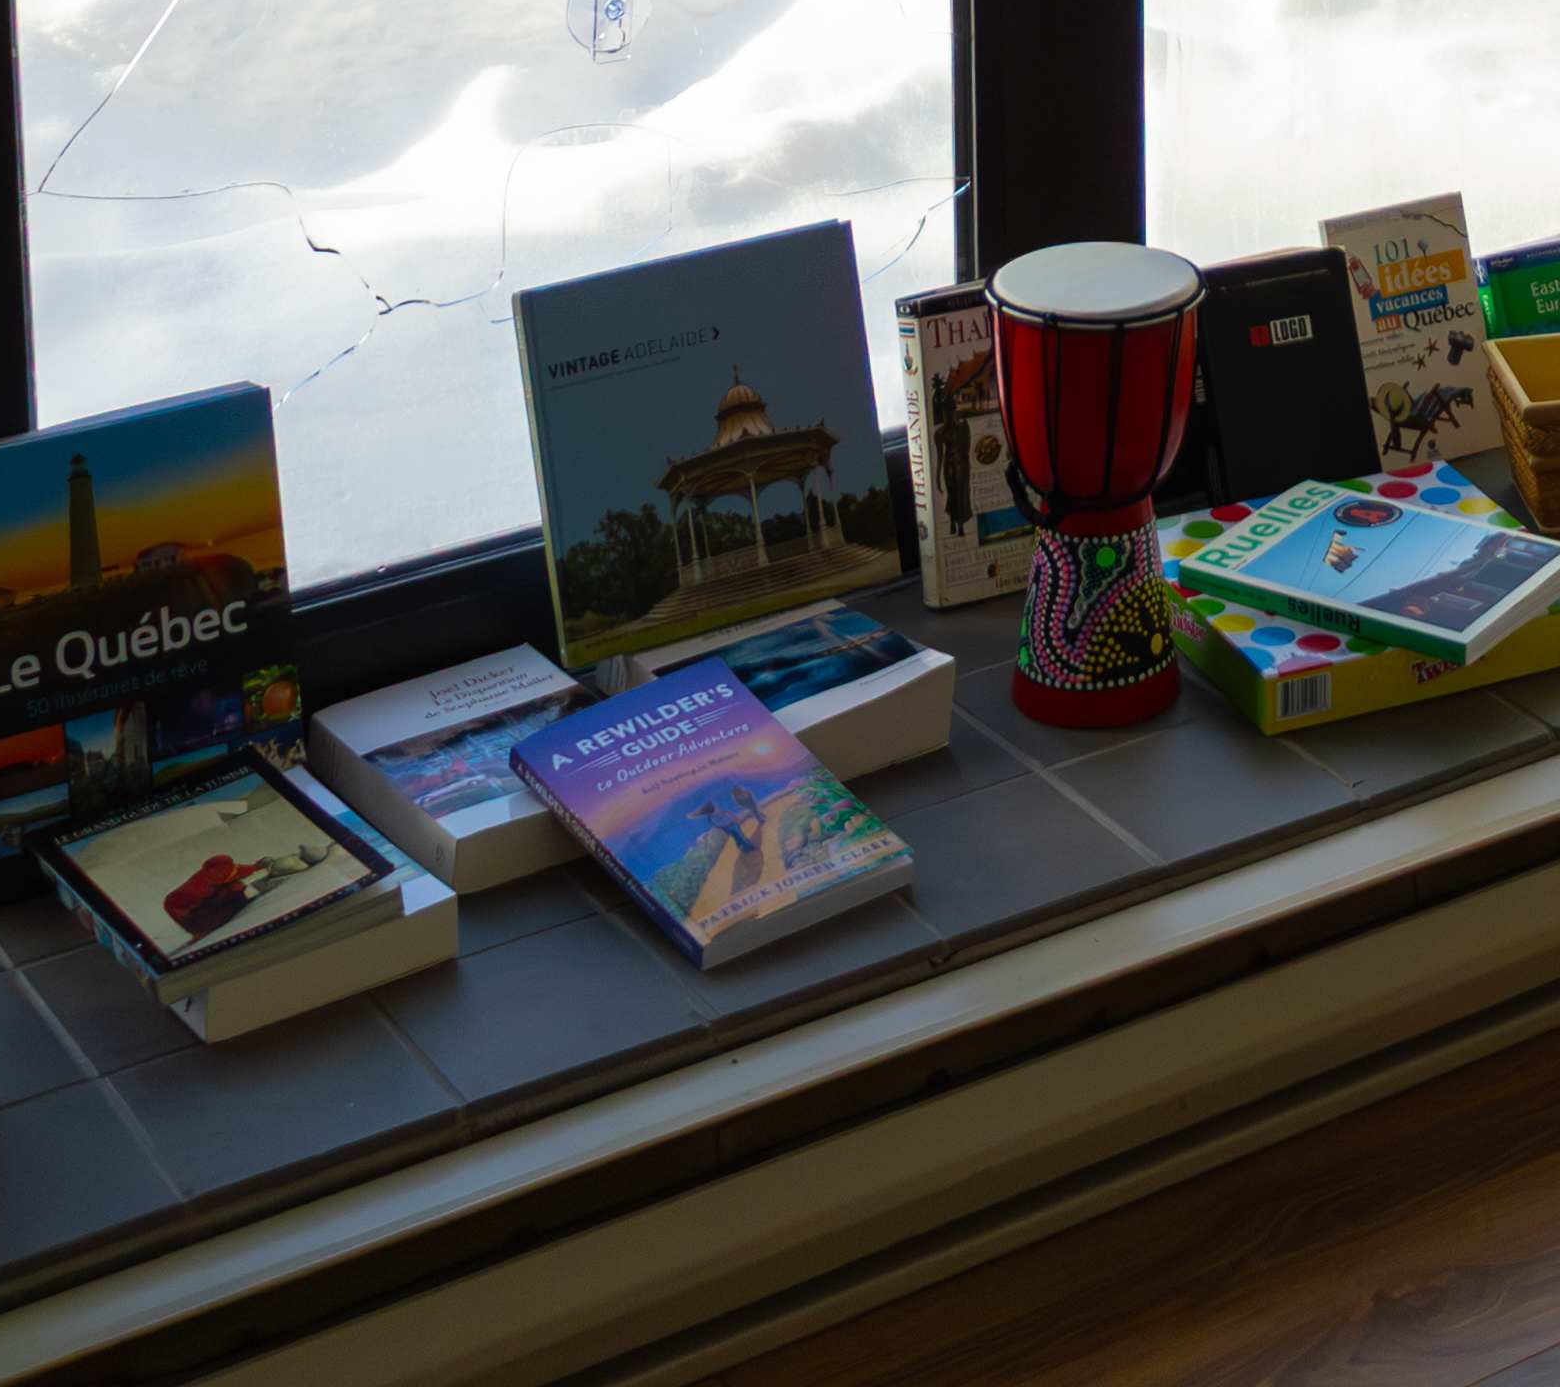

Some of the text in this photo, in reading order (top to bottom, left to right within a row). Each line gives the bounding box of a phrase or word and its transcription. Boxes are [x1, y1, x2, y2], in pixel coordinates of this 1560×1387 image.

[1374, 238, 1411, 264] 101
[1384, 258, 1453, 293] idées
[1376, 290, 1444, 313] vacances
[1377, 316, 1398, 329] au
[548, 348, 621, 379] VINTAGE
[624, 327, 708, 361] ADELAIDE
[1196, 487, 1336, 568] Ruelles
[1288, 597, 1360, 634] Ruelles
[55, 600, 248, 679] Québec
[25, 697, 50, 718] 50
[144, 667, 168, 686] de
[463, 665, 515, 689] Dicker
[552, 683, 734, 771] A REWILDER'S
[620, 719, 699, 758] GUIDE
[596, 722, 750, 792] to Outdoor Adventure
[700, 838, 892, 929] PATRICK JOSEPH CLARK
